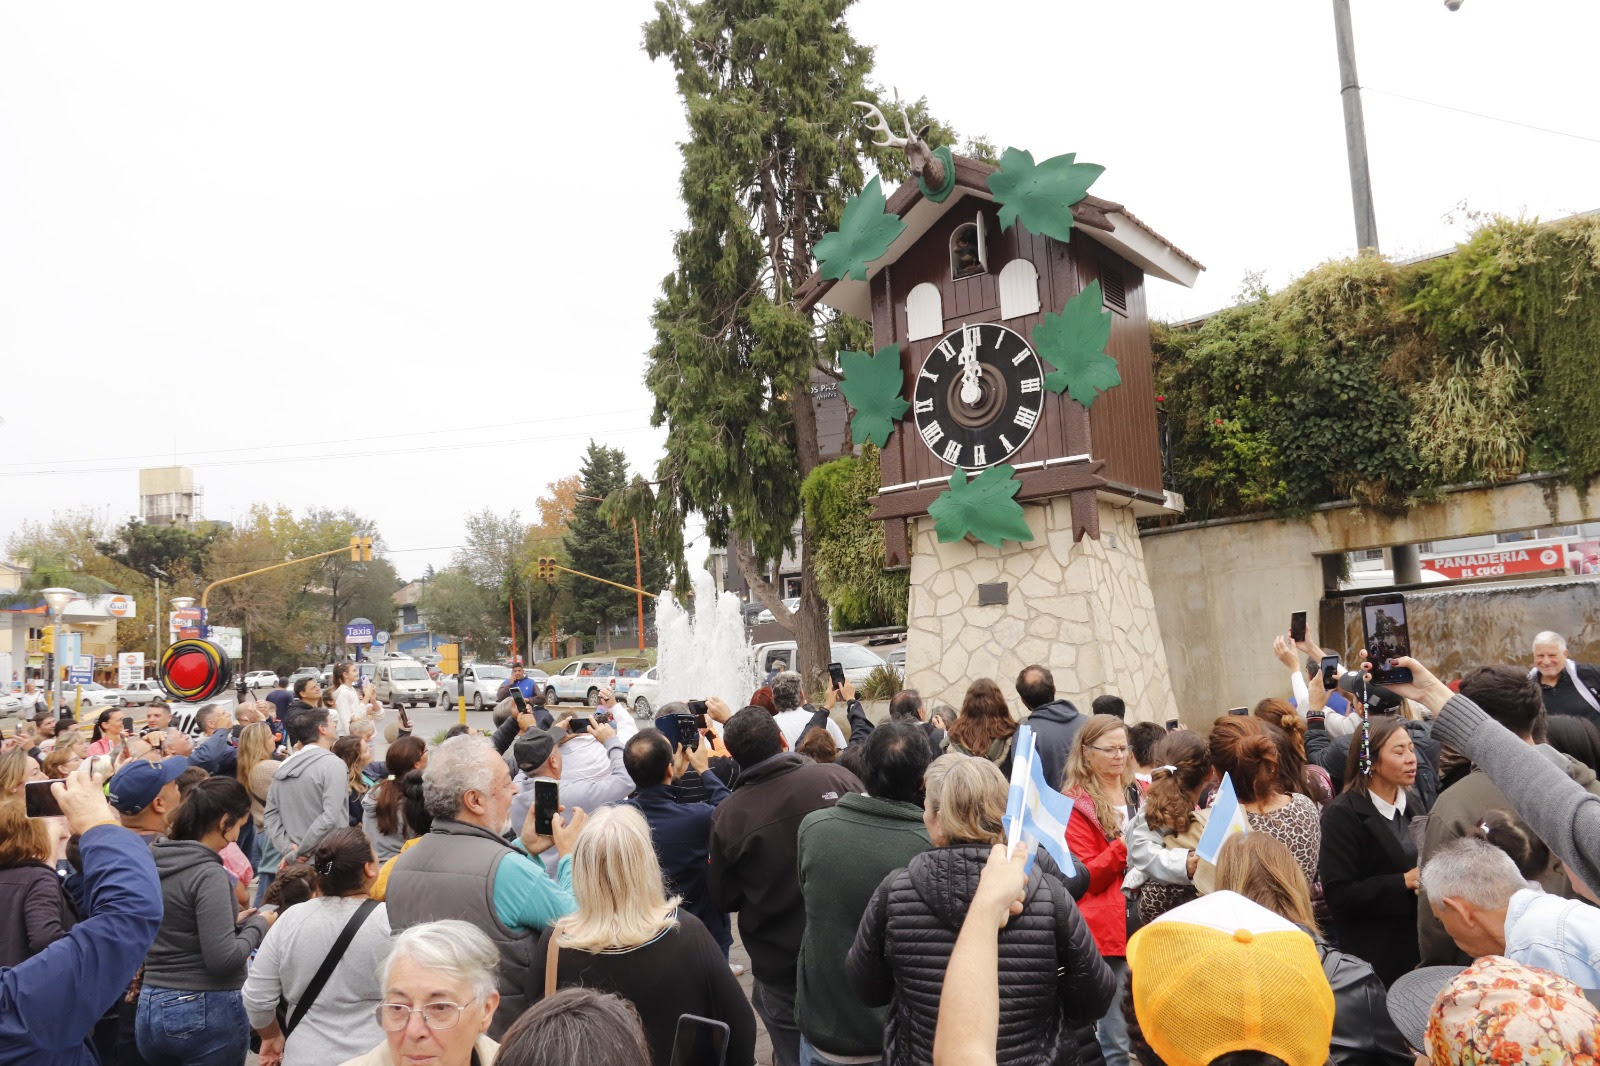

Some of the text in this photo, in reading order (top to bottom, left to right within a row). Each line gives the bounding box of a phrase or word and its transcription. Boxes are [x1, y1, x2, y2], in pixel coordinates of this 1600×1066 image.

[938, 340, 956, 361] XI
[1012, 347, 1031, 367] II
[920, 368, 939, 383] X
[1020, 377, 1040, 394] III
[915, 397, 934, 413] IX
[999, 433, 1015, 453] V
[974, 444, 987, 466] VI
[1434, 550, 1530, 569] PANADERIA
[1462, 564, 1505, 577] EL CUCÚ
[347, 627, 371, 636] Taxis
